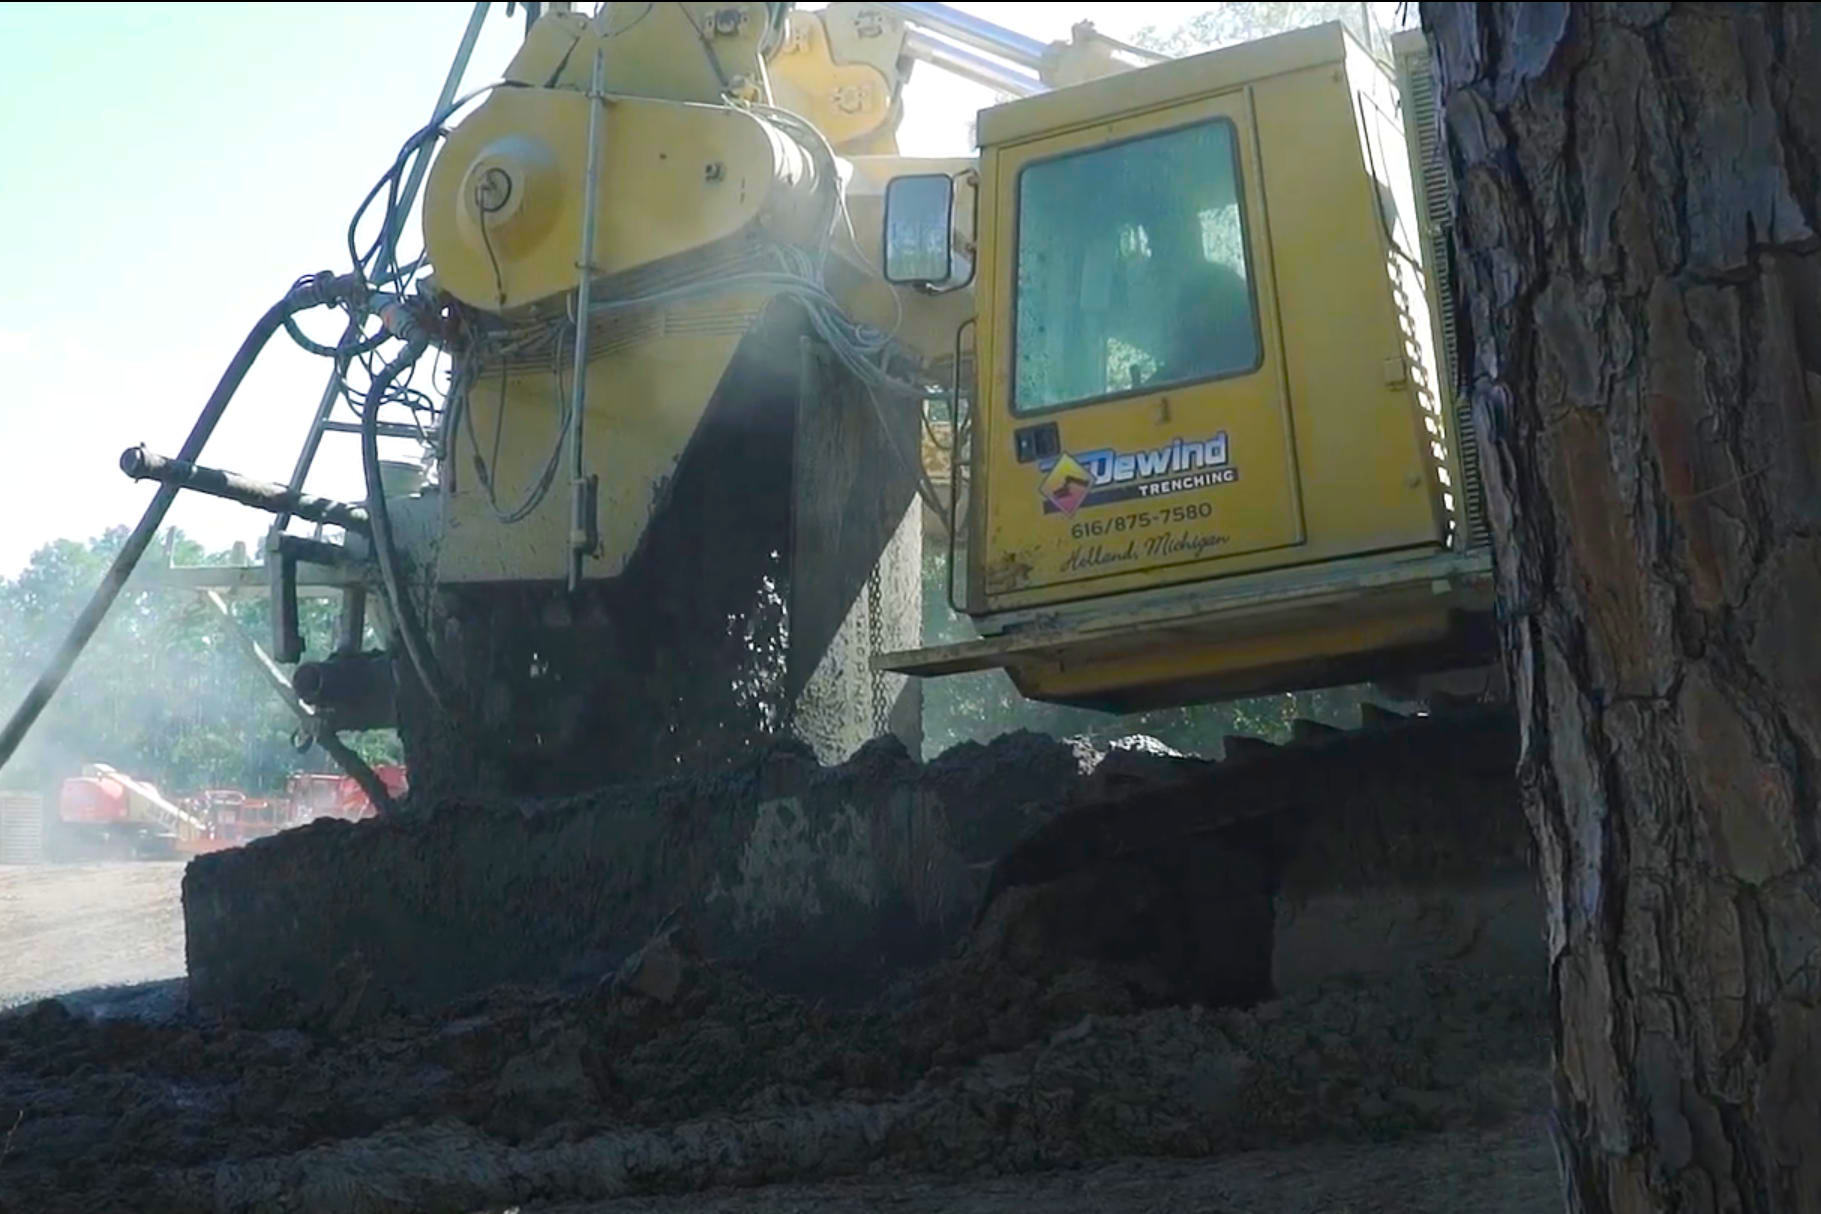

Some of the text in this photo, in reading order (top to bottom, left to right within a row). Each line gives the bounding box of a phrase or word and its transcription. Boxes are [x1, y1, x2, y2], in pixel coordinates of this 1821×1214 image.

[1086, 430, 1229, 485] Dewind
[1139, 469, 1234, 497] TRENCHING
[1071, 502, 1213, 539] 616/875-7580
[1142, 531, 1231, 560] Michigan
